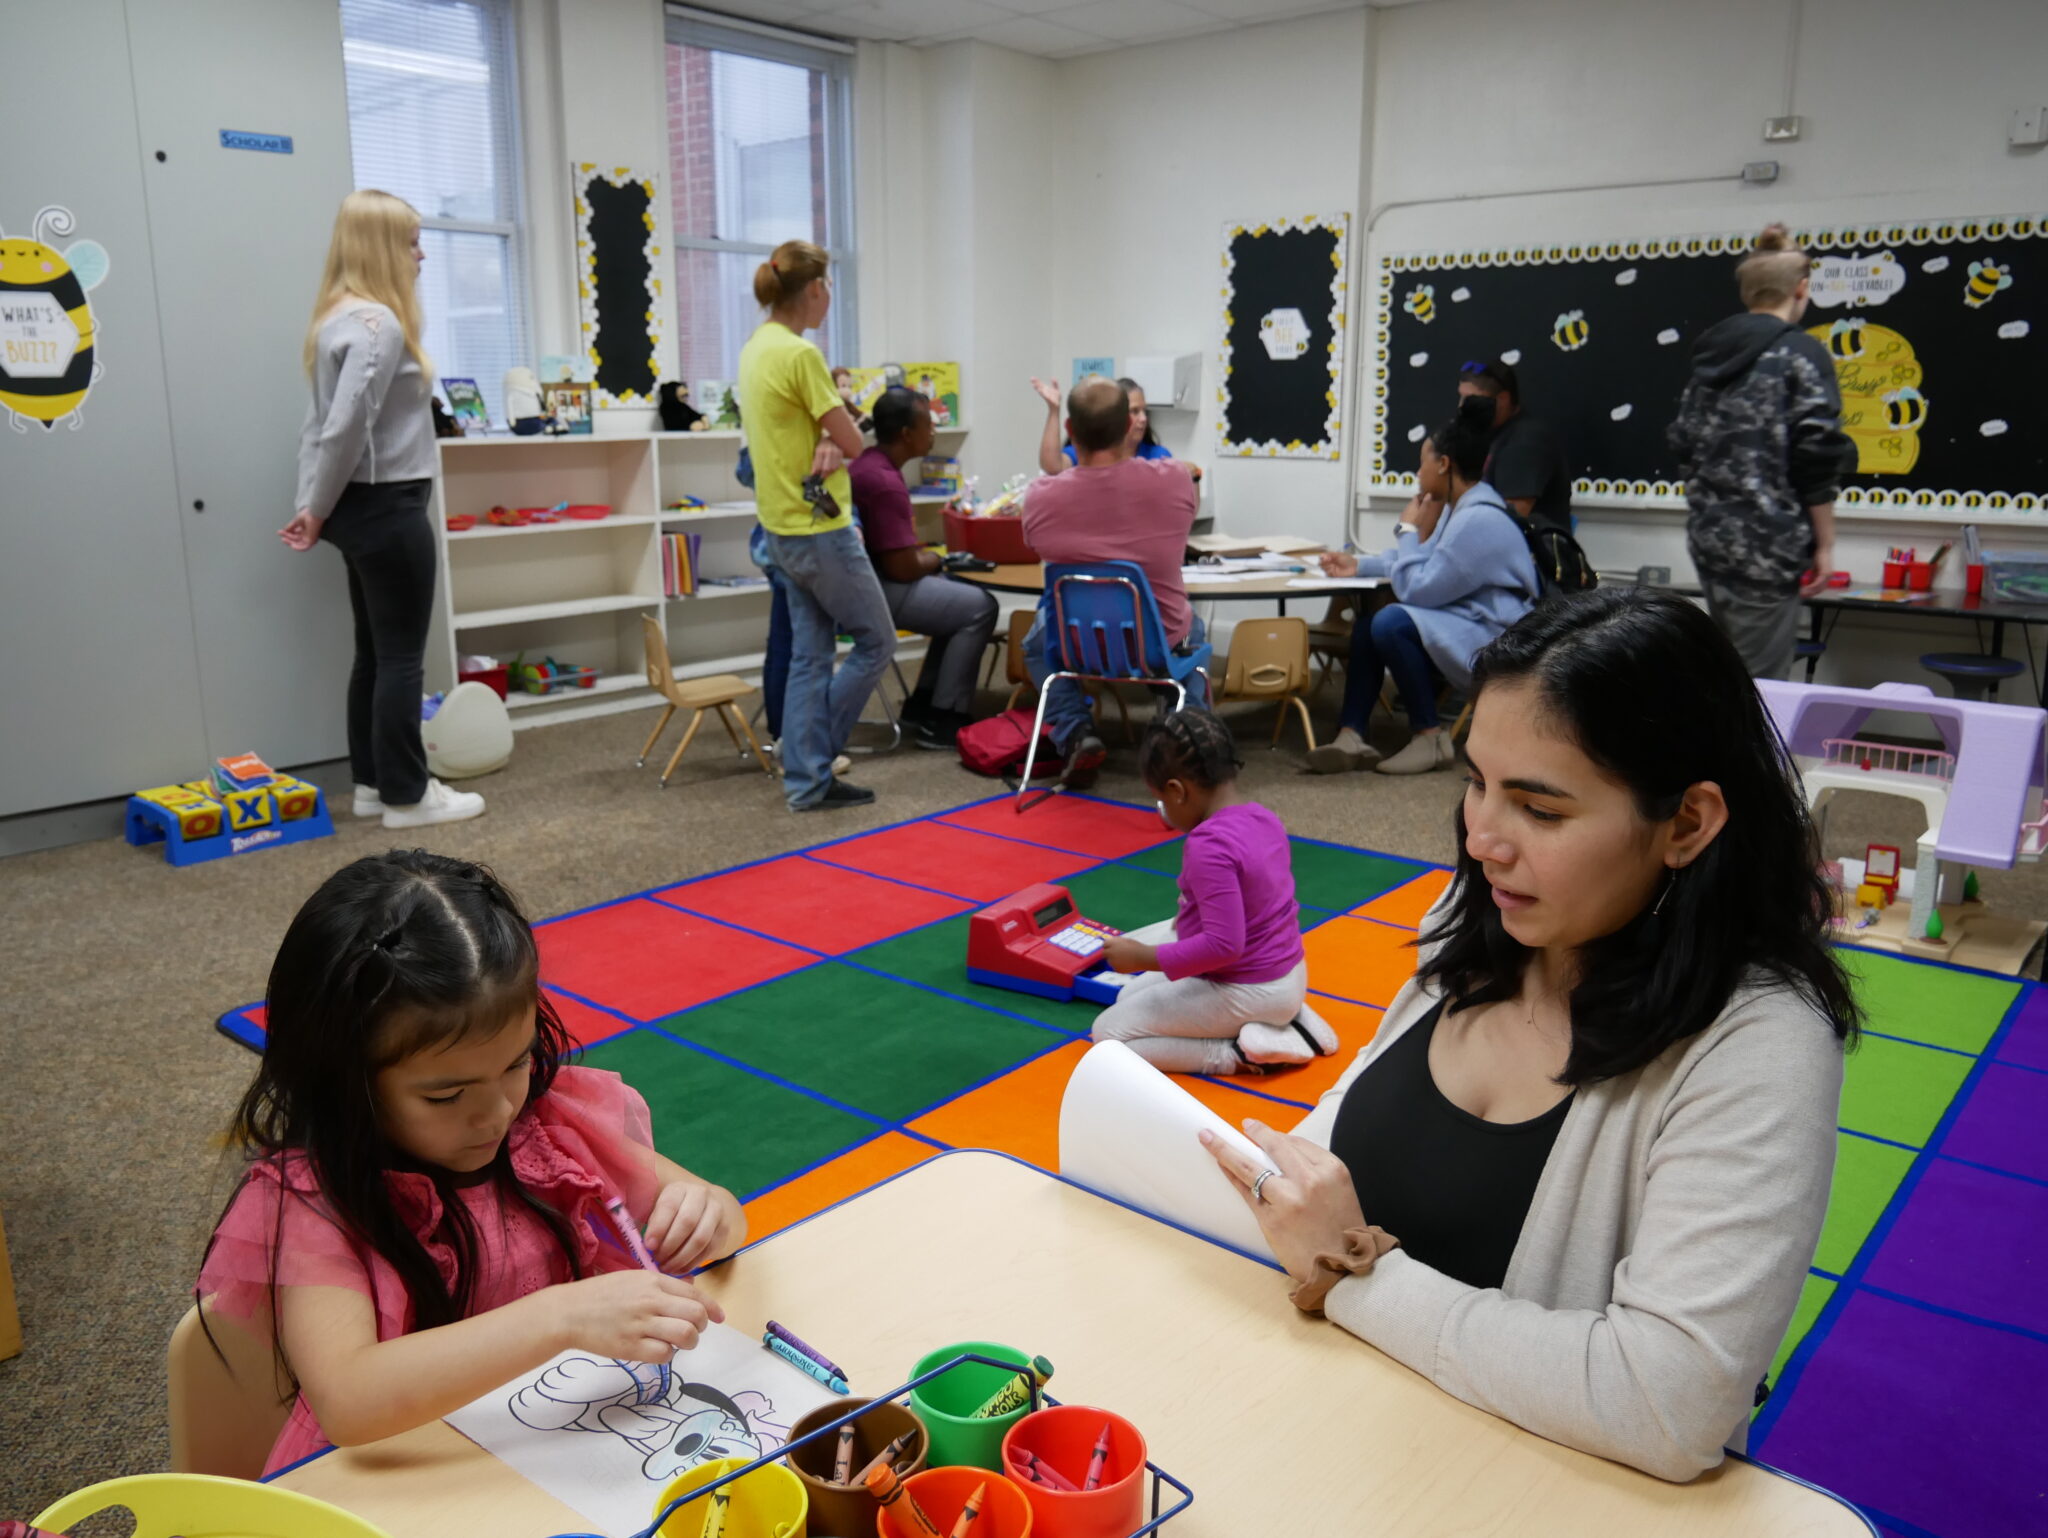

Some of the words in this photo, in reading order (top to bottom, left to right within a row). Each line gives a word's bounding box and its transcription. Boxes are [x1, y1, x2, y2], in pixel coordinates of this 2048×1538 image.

[1844, 265, 1868, 278] CLASS
[1, 306, 54, 324] WHAT'S
[5, 339, 58, 363] BUZZ?
[776, 1344, 818, 1377] Lakeshore
